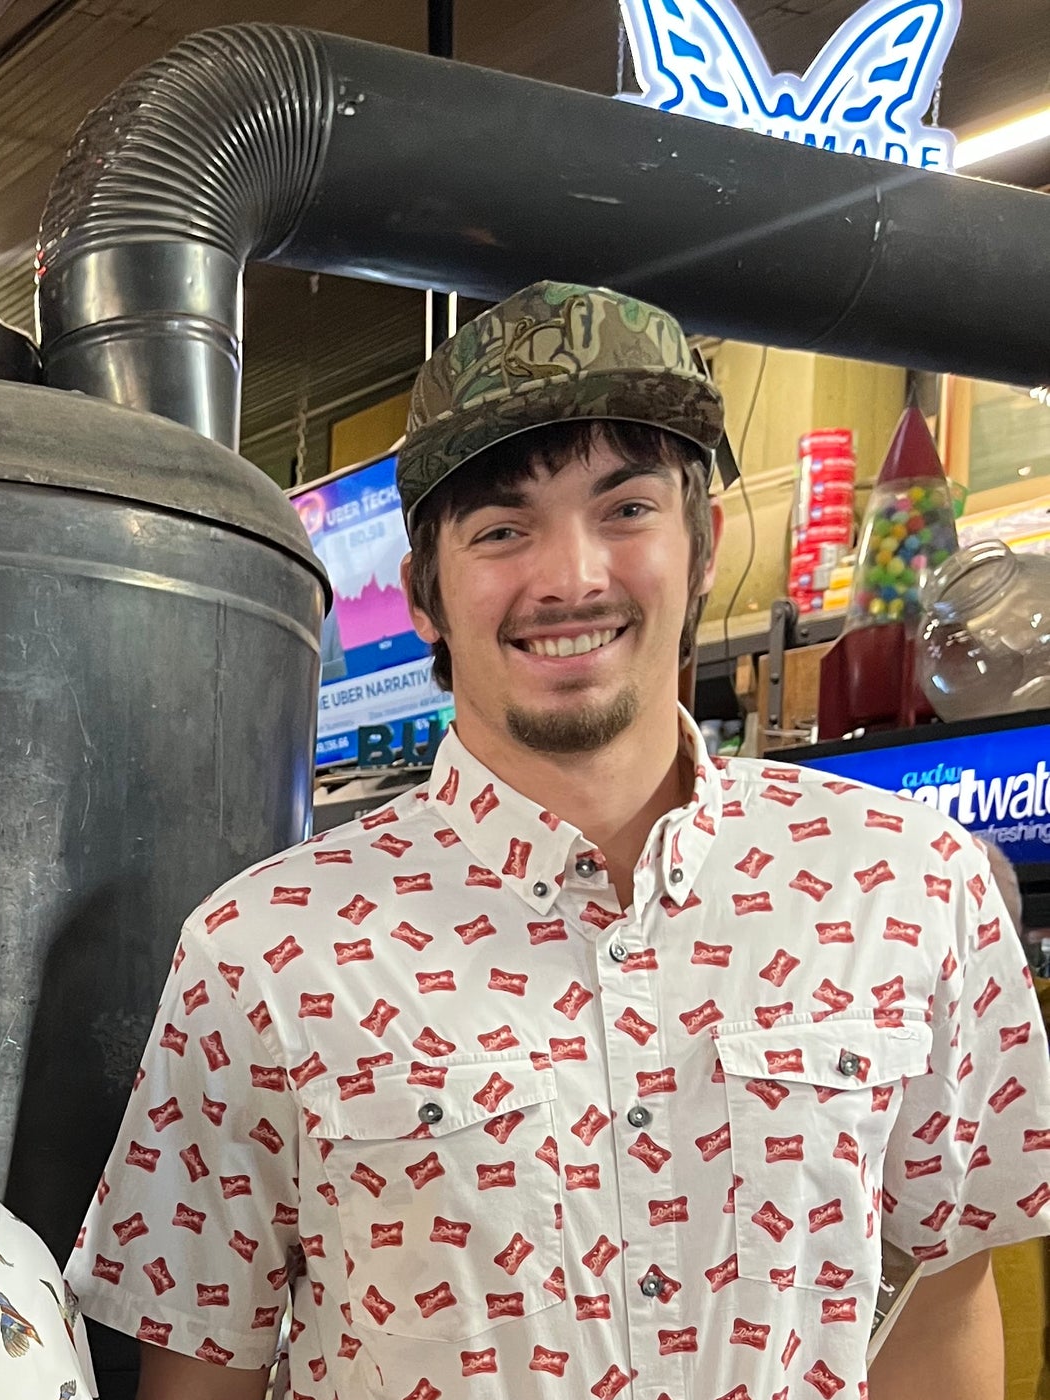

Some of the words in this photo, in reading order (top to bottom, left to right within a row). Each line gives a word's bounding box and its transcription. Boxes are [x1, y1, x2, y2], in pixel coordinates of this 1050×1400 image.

[325, 500, 361, 526] UBER
[361, 484, 401, 513] TECH
[332, 686, 363, 707] UBER
[366, 667, 431, 699] NARRATIV
